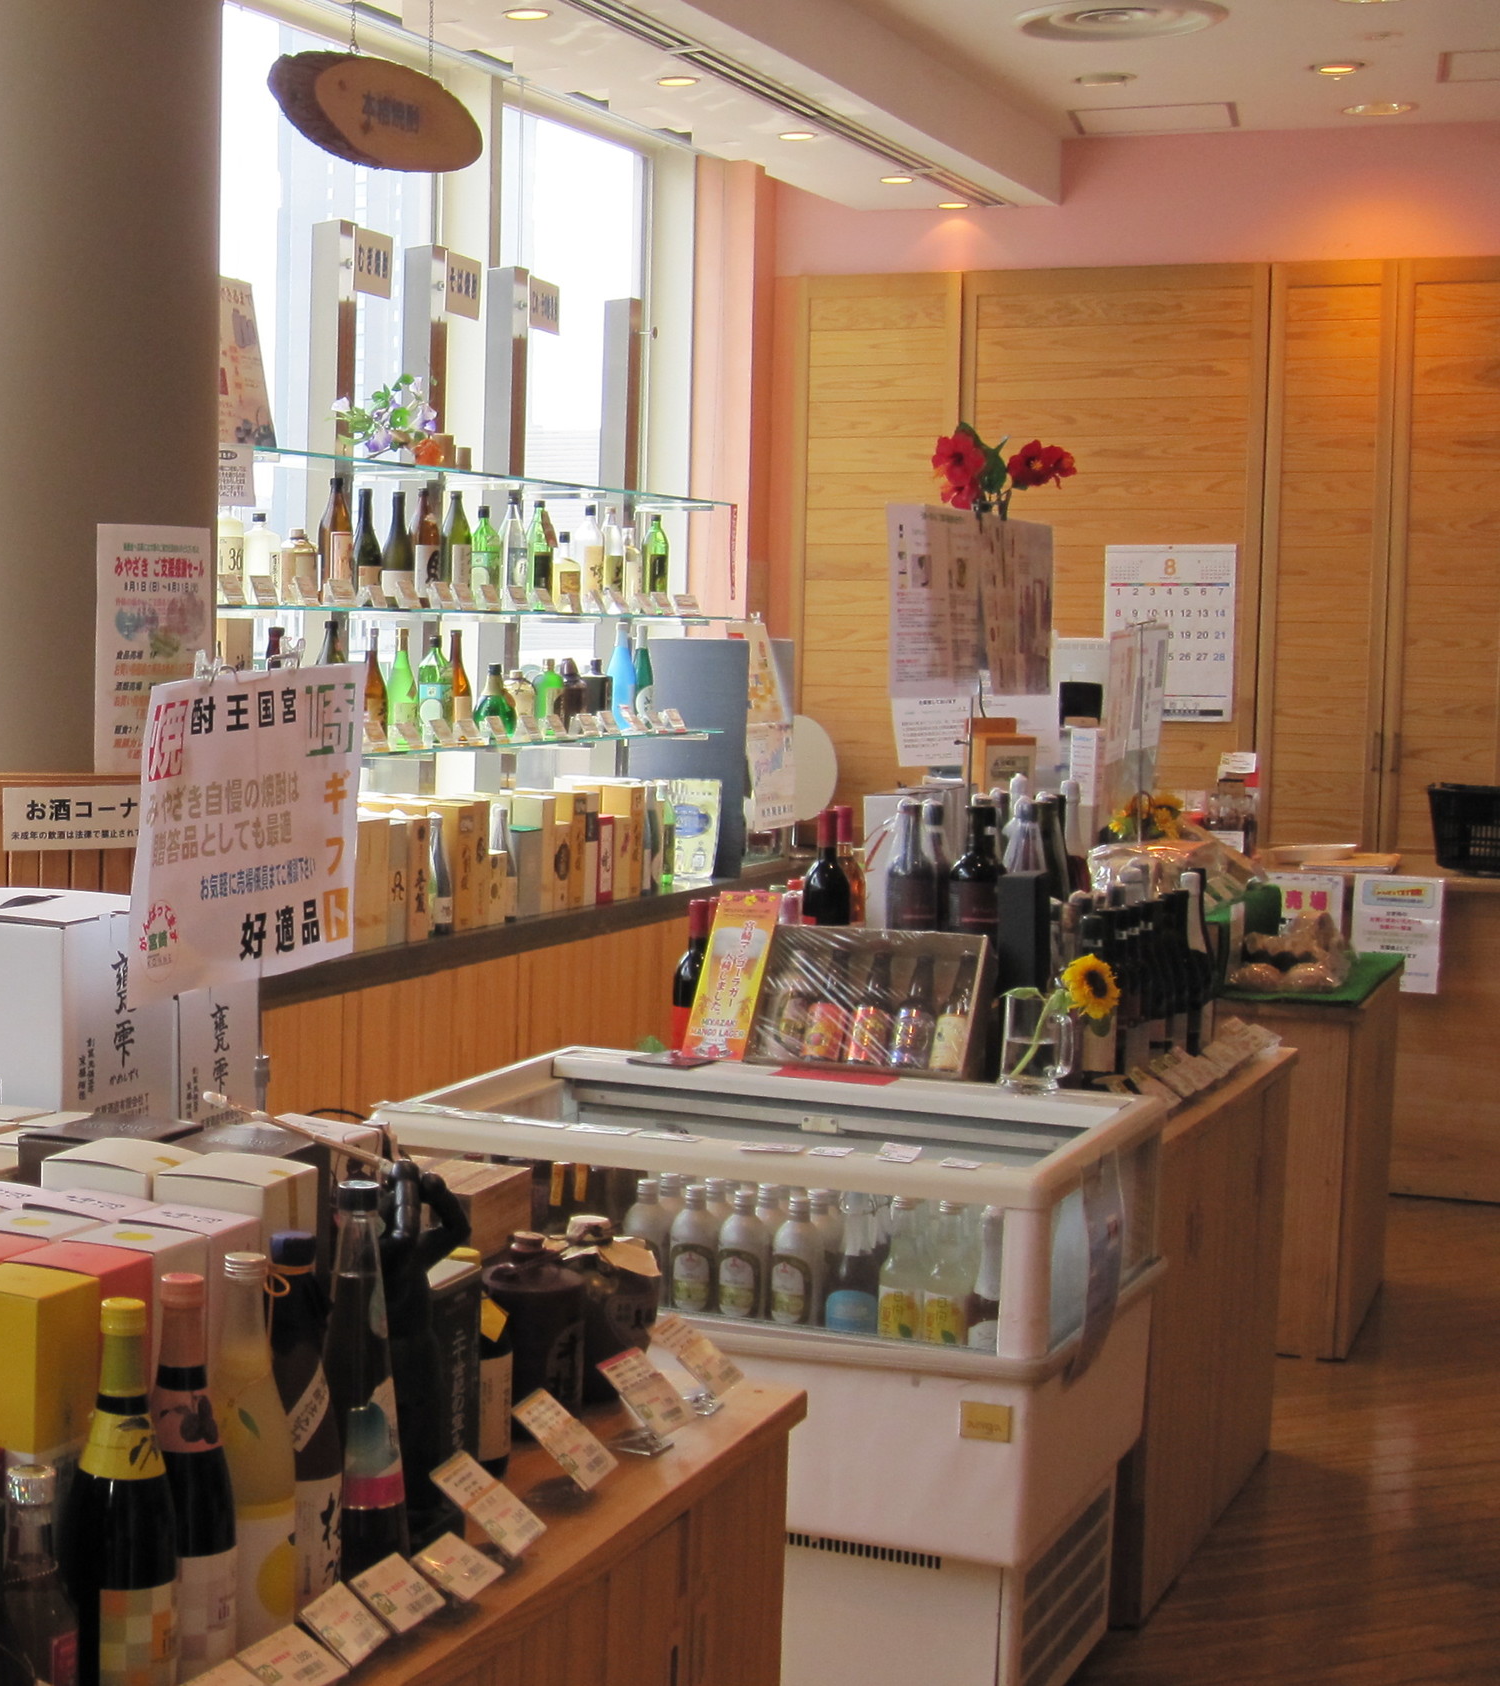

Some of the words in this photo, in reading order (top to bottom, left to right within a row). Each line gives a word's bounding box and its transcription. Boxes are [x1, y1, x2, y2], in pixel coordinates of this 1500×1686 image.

[114, 557, 148, 577] みやざき
[1164, 558, 1176, 576] 8
[1115, 609, 1121, 618] 8
[1132, 609, 1138, 618] 9
[1164, 609, 1174, 618] 11
[1181, 609, 1191, 618] 12
[1197, 609, 1208, 618] 13
[1215, 609, 1226, 618] 14
[1180, 631, 1191, 640] 19
[1196, 631, 1209, 640] 20
[1214, 631, 1225, 640] 21
[1178, 653, 1191, 661] 26
[1196, 653, 1208, 661] 27
[1213, 653, 1226, 661] 28
[145, 772, 300, 824] みやざき自慢の焼酎は
[26, 797, 138, 821] お酒コーナ
[152, 810, 293, 867] 贈答品としても最適
[240, 899, 320, 962] 好適品
[690, 1026, 718, 1037] MANGO
[718, 1026, 746, 1039] LAGER
